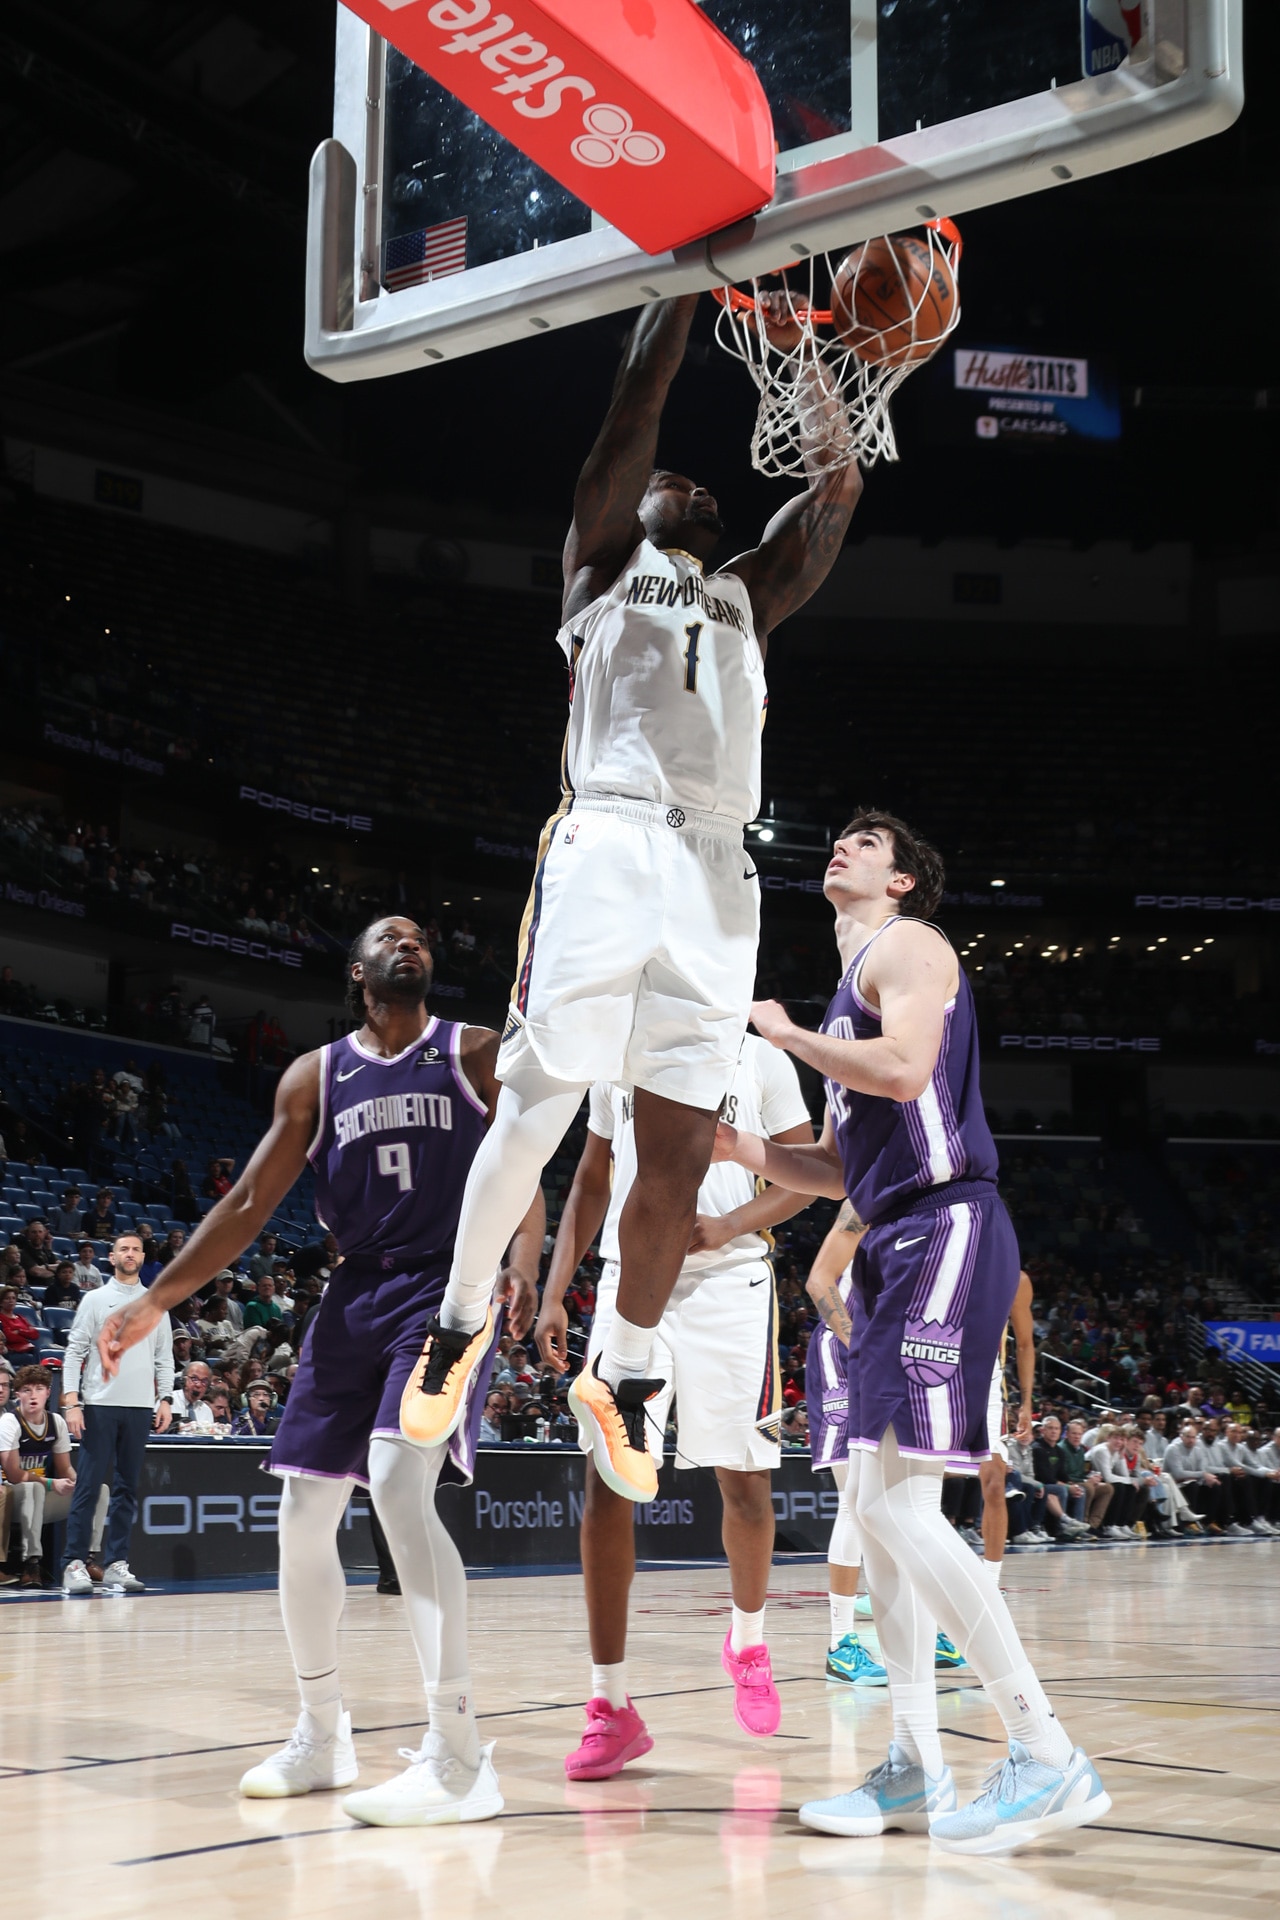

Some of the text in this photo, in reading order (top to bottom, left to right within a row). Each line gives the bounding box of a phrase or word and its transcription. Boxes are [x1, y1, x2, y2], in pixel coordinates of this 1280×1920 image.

[427, 0, 596, 119] State
[1091, 42, 1121, 73] NBA
[1000, 417, 1069, 436] CAESARS
[624, 575, 682, 609] NEW
[683, 620, 705, 695] 1
[44, 723, 165, 777] Porsche New Orleans
[240, 785, 373, 833] PORSCHE
[5, 881, 36, 905] New
[37, 889, 86, 918] Orleans
[170, 922, 303, 968] PORSCHE
[1000, 1035, 1161, 1052] PORSCHE
[333, 1092, 453, 1151] SACRAMENTO
[376, 1142, 414, 1194] 9
[901, 1341, 961, 1365] KINGS
[475, 1490, 563, 1528] Porsche
